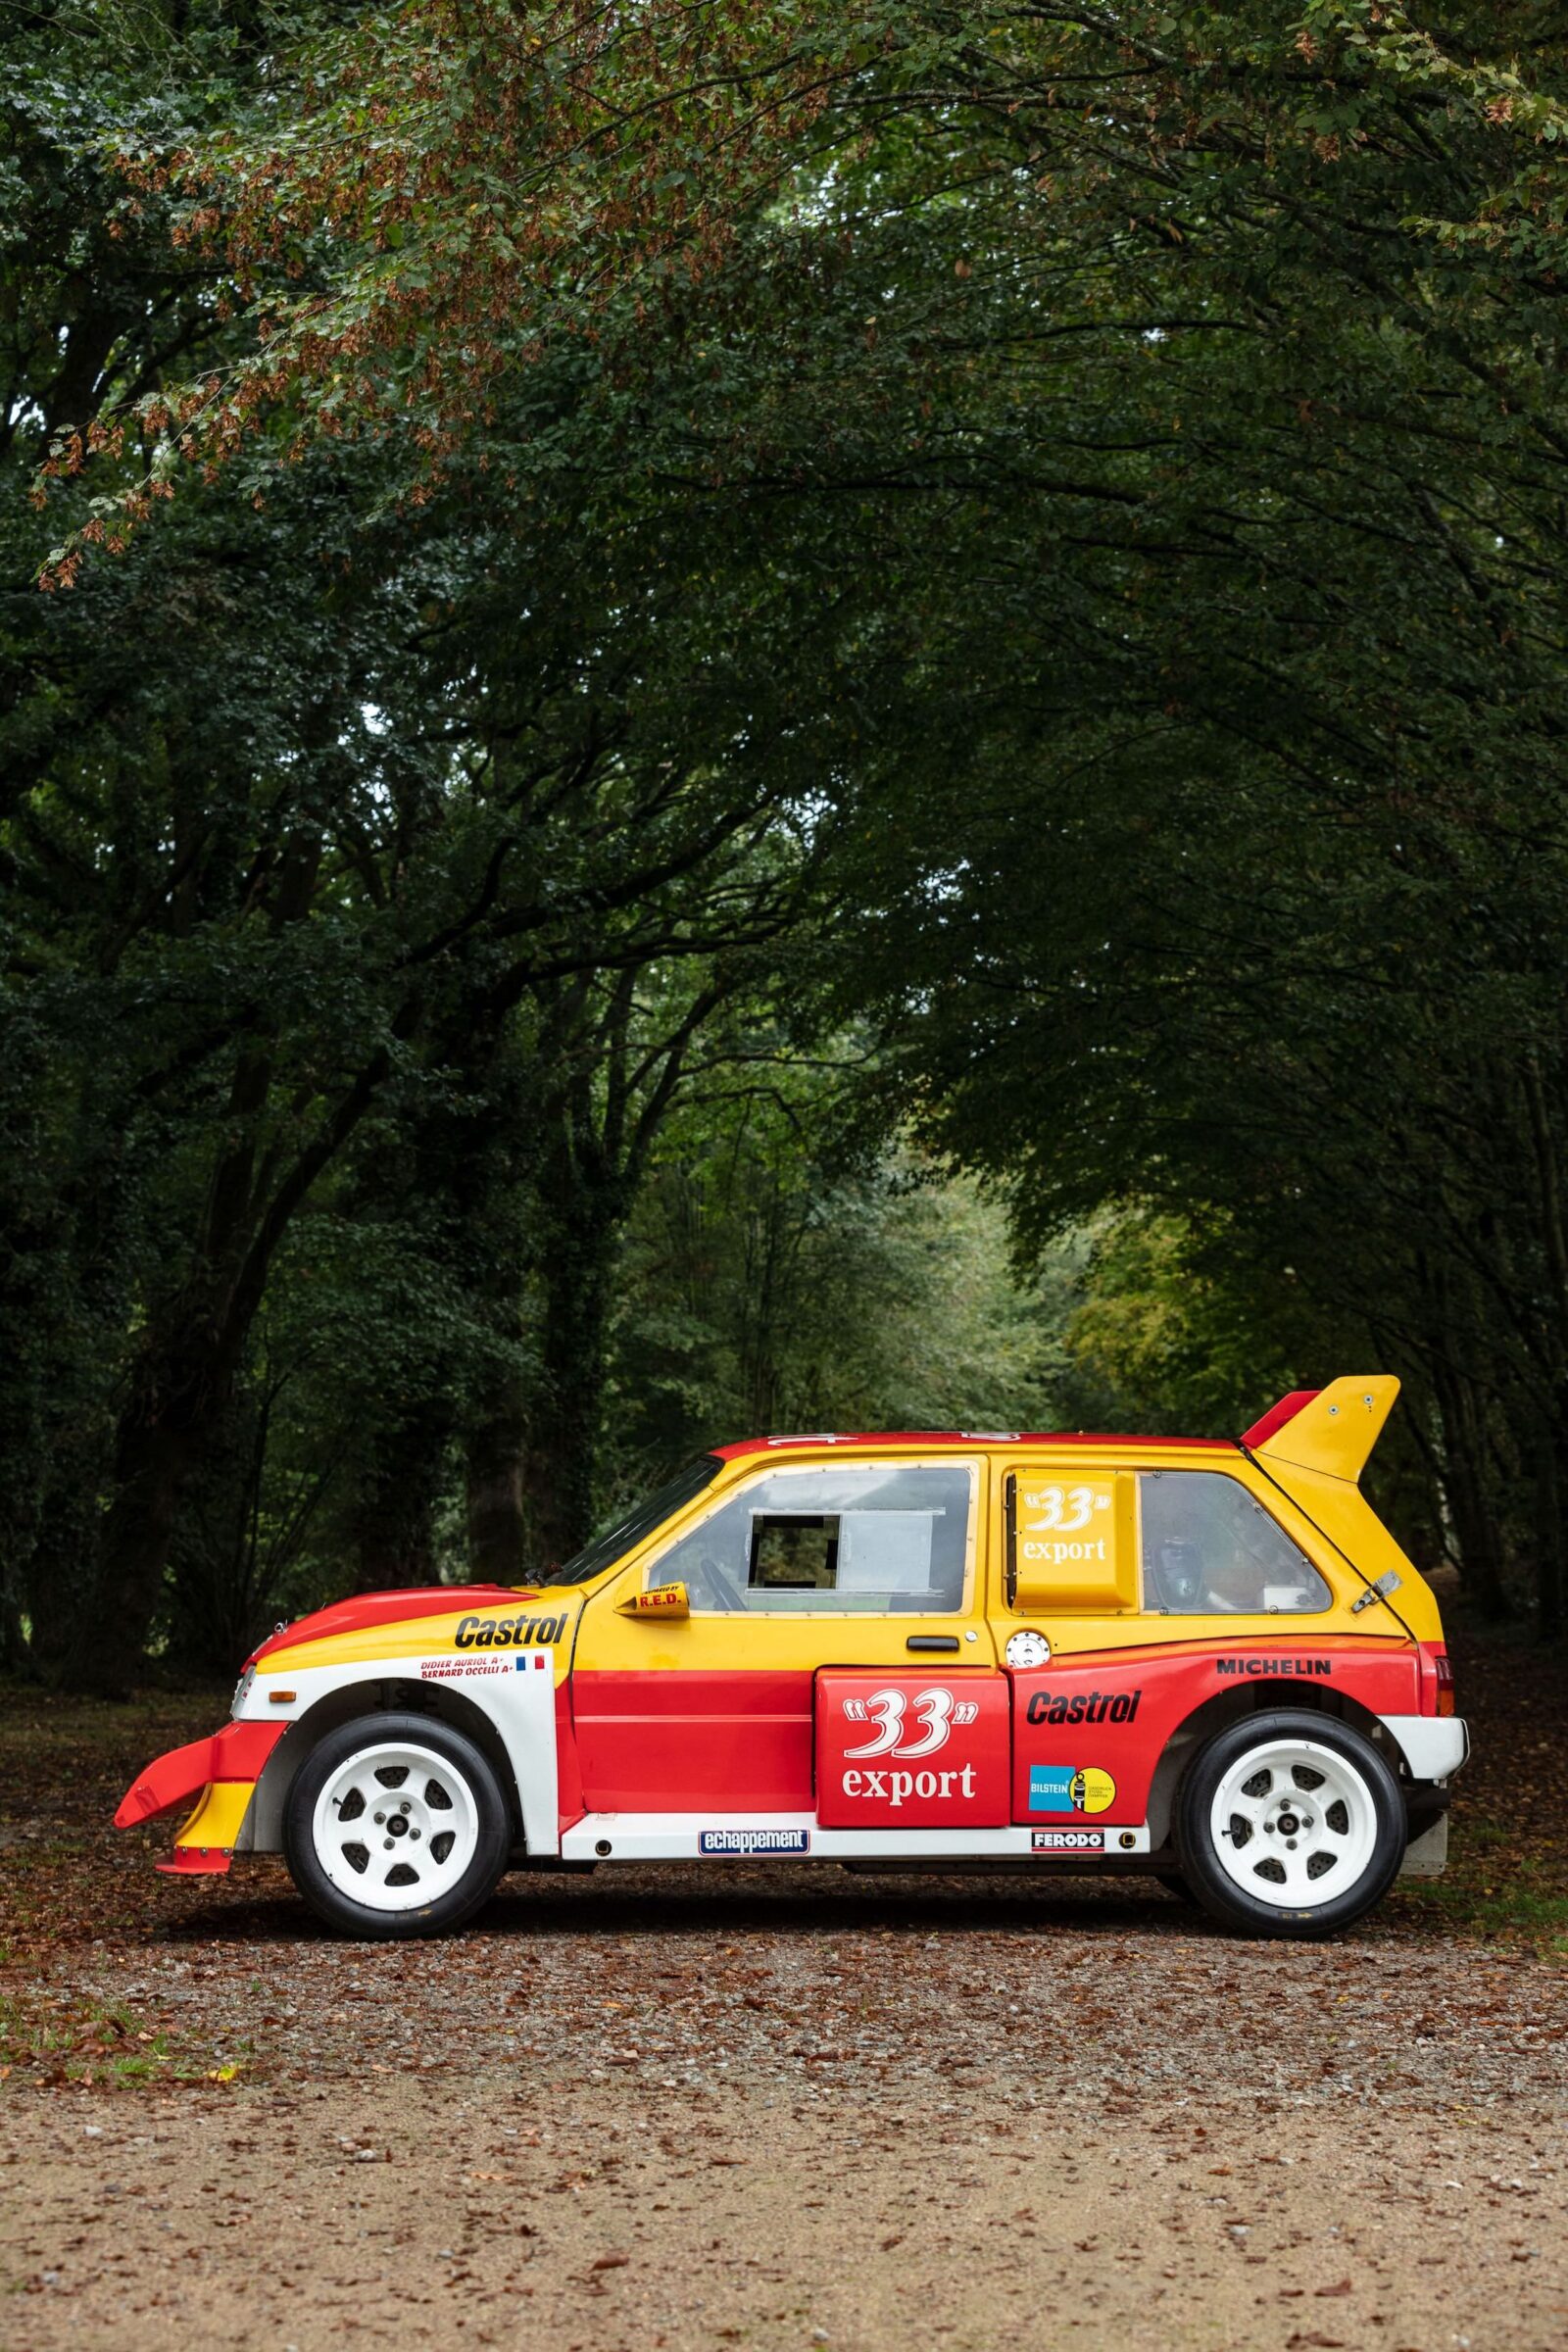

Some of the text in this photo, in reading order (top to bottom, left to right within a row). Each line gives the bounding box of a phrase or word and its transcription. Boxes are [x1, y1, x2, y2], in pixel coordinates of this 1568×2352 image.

[1023, 1538, 1105, 1564] export
[640, 1592, 681, 1607] R.E.D.
[455, 1613, 568, 1648] Castrol
[420, 1660, 452, 1670] DIDIER
[455, 1657, 487, 1667] AURIOL
[1216, 1659, 1332, 1675] MICHELIN
[421, 1668, 464, 1679] BERNARD
[466, 1666, 500, 1676] OCCELLI
[1026, 1690, 1142, 1725] Castrol
[842, 1763, 977, 1806] export
[1030, 1783, 1068, 1794] BILSTEIN
[705, 1831, 804, 1853] echappement
[1034, 1833, 1102, 1847] FERODO
